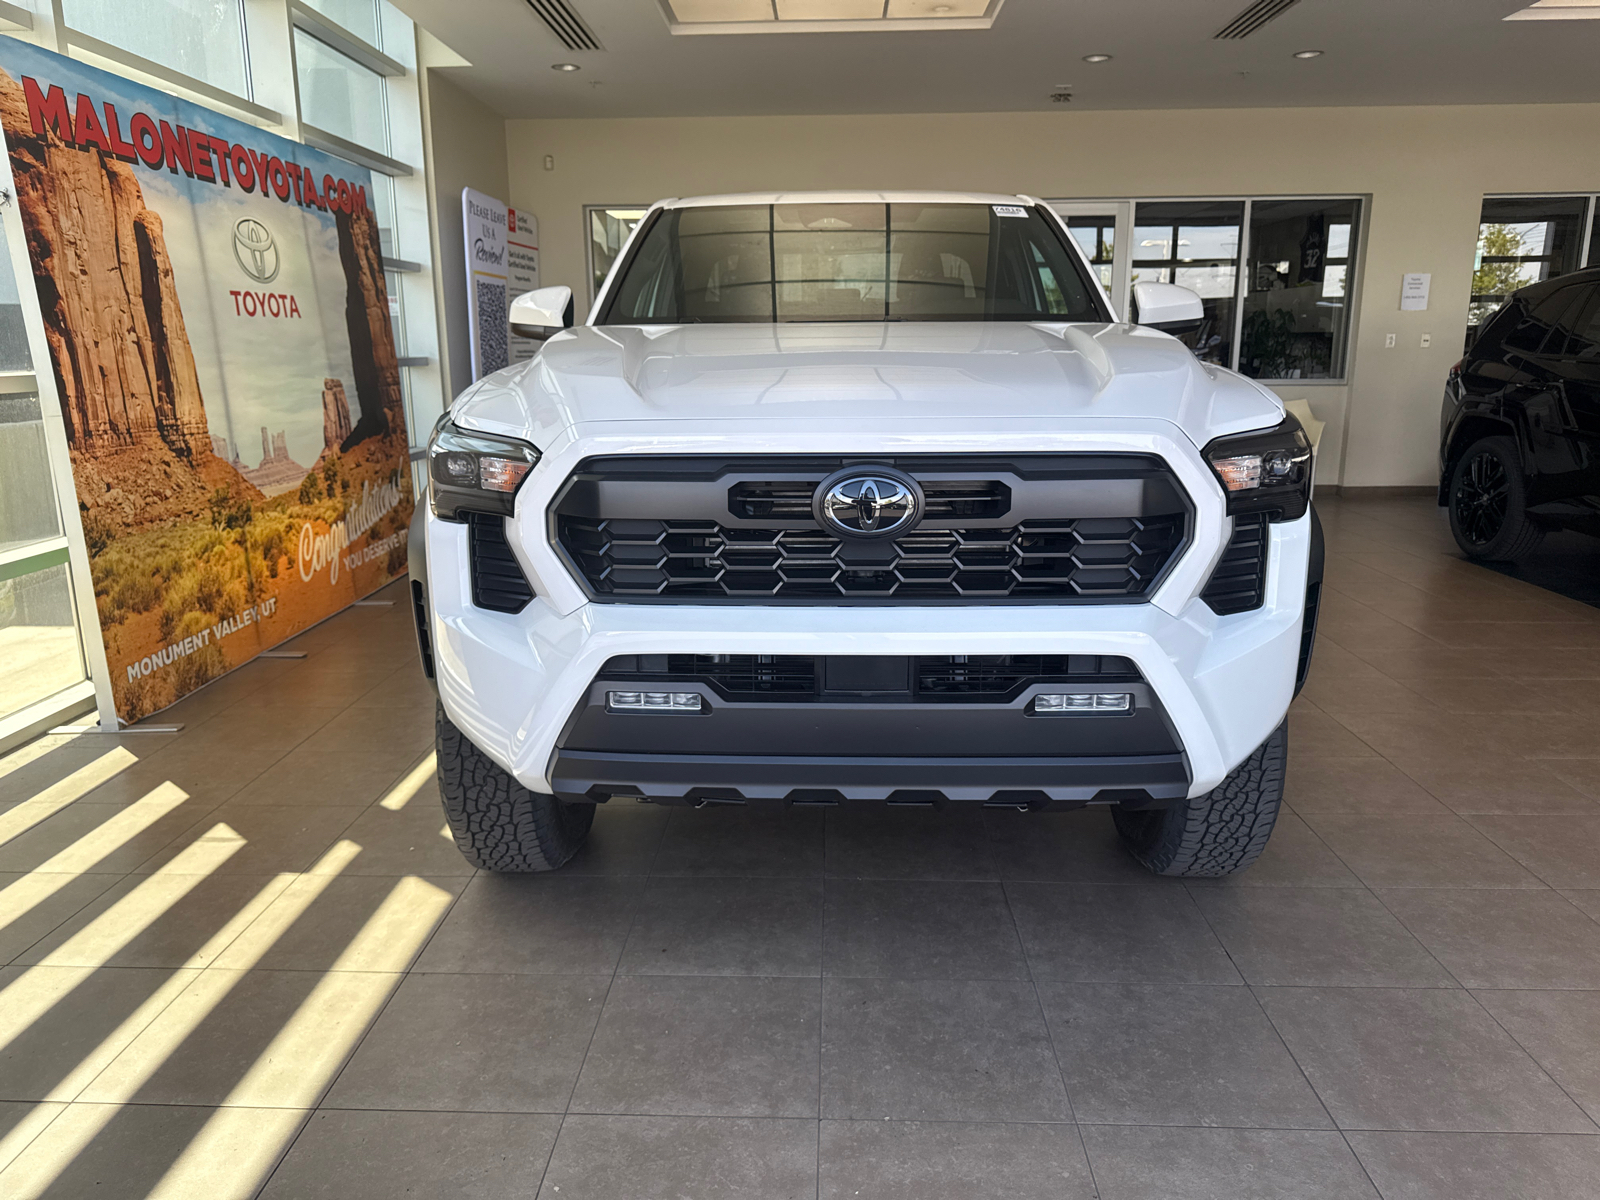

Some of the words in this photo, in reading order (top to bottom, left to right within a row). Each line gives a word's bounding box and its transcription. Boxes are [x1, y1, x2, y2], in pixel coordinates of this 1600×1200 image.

[21, 75, 369, 215] MALONETOYOTA.COM
[468, 200, 490, 221] PLEASE
[490, 208, 507, 226] LEAVE
[491, 227, 497, 241] A
[474, 237, 505, 267] Review!
[1304, 248, 1320, 268] 32
[229, 290, 302, 319] TOYOTA
[299, 456, 404, 586] Congratulations!
[343, 550, 363, 571] YOU
[363, 533, 399, 562] DESERVE
[126, 628, 211, 684] MONUMENT
[212, 605, 261, 640] VALLEY,
[261, 597, 277, 617] UT
